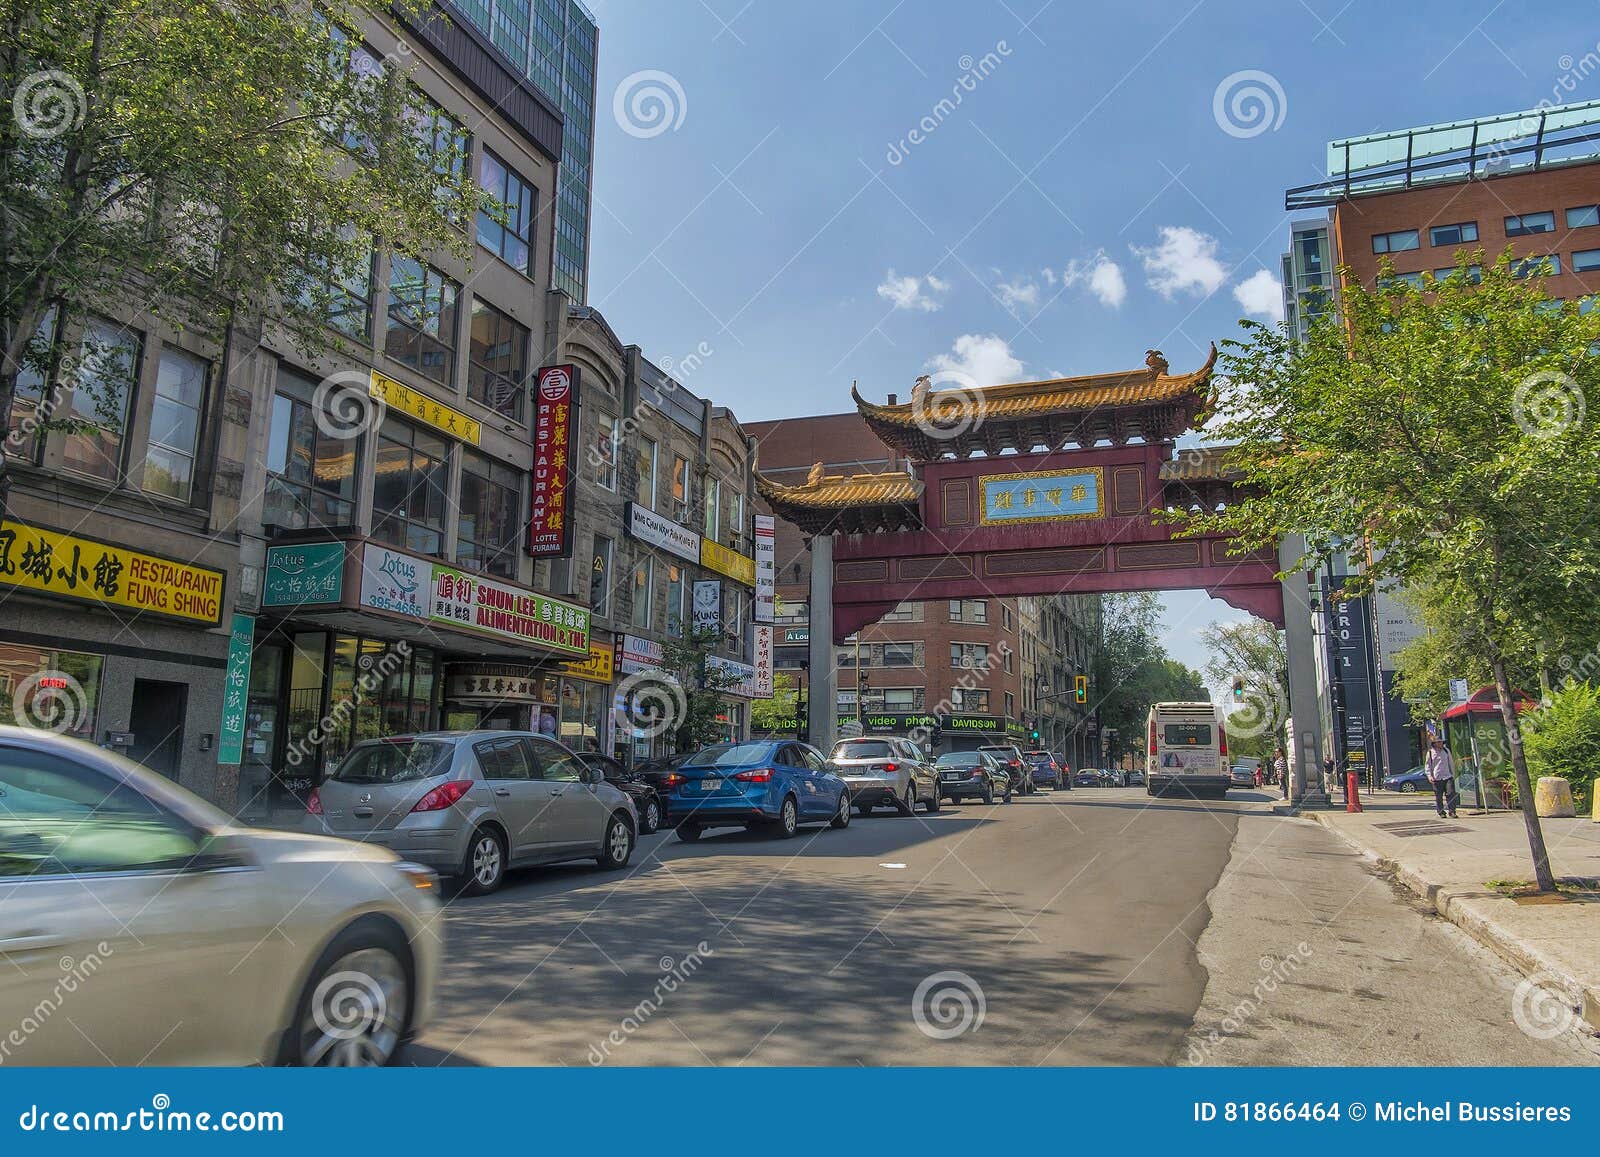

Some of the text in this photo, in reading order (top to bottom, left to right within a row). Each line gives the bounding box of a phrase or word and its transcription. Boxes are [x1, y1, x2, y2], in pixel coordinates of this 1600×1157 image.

[533, 404, 550, 531] RESTAURANT
[546, 403, 569, 530] 富麗華大酒樓
[532, 543, 561, 553] FURAMA
[535, 533, 558, 542] LOTTE
[269, 552, 306, 572] Lotus
[378, 551, 416, 579] Lotus
[129, 557, 220, 596] RESTAURANT
[436, 572, 472, 604] 順利
[126, 581, 217, 619] FUNG SHING
[369, 594, 422, 617] 395-4665
[477, 585, 536, 617] SHUN LEE
[476, 607, 557, 643] ALIMENTATION
[558, 630, 566, 645] &
[693, 611, 719, 622] KUNG
[1338, 601, 1351, 640] ERO
[868, 716, 897, 725] video
[905, 715, 936, 727] photo
[952, 719, 997, 729] DAVIDSON
